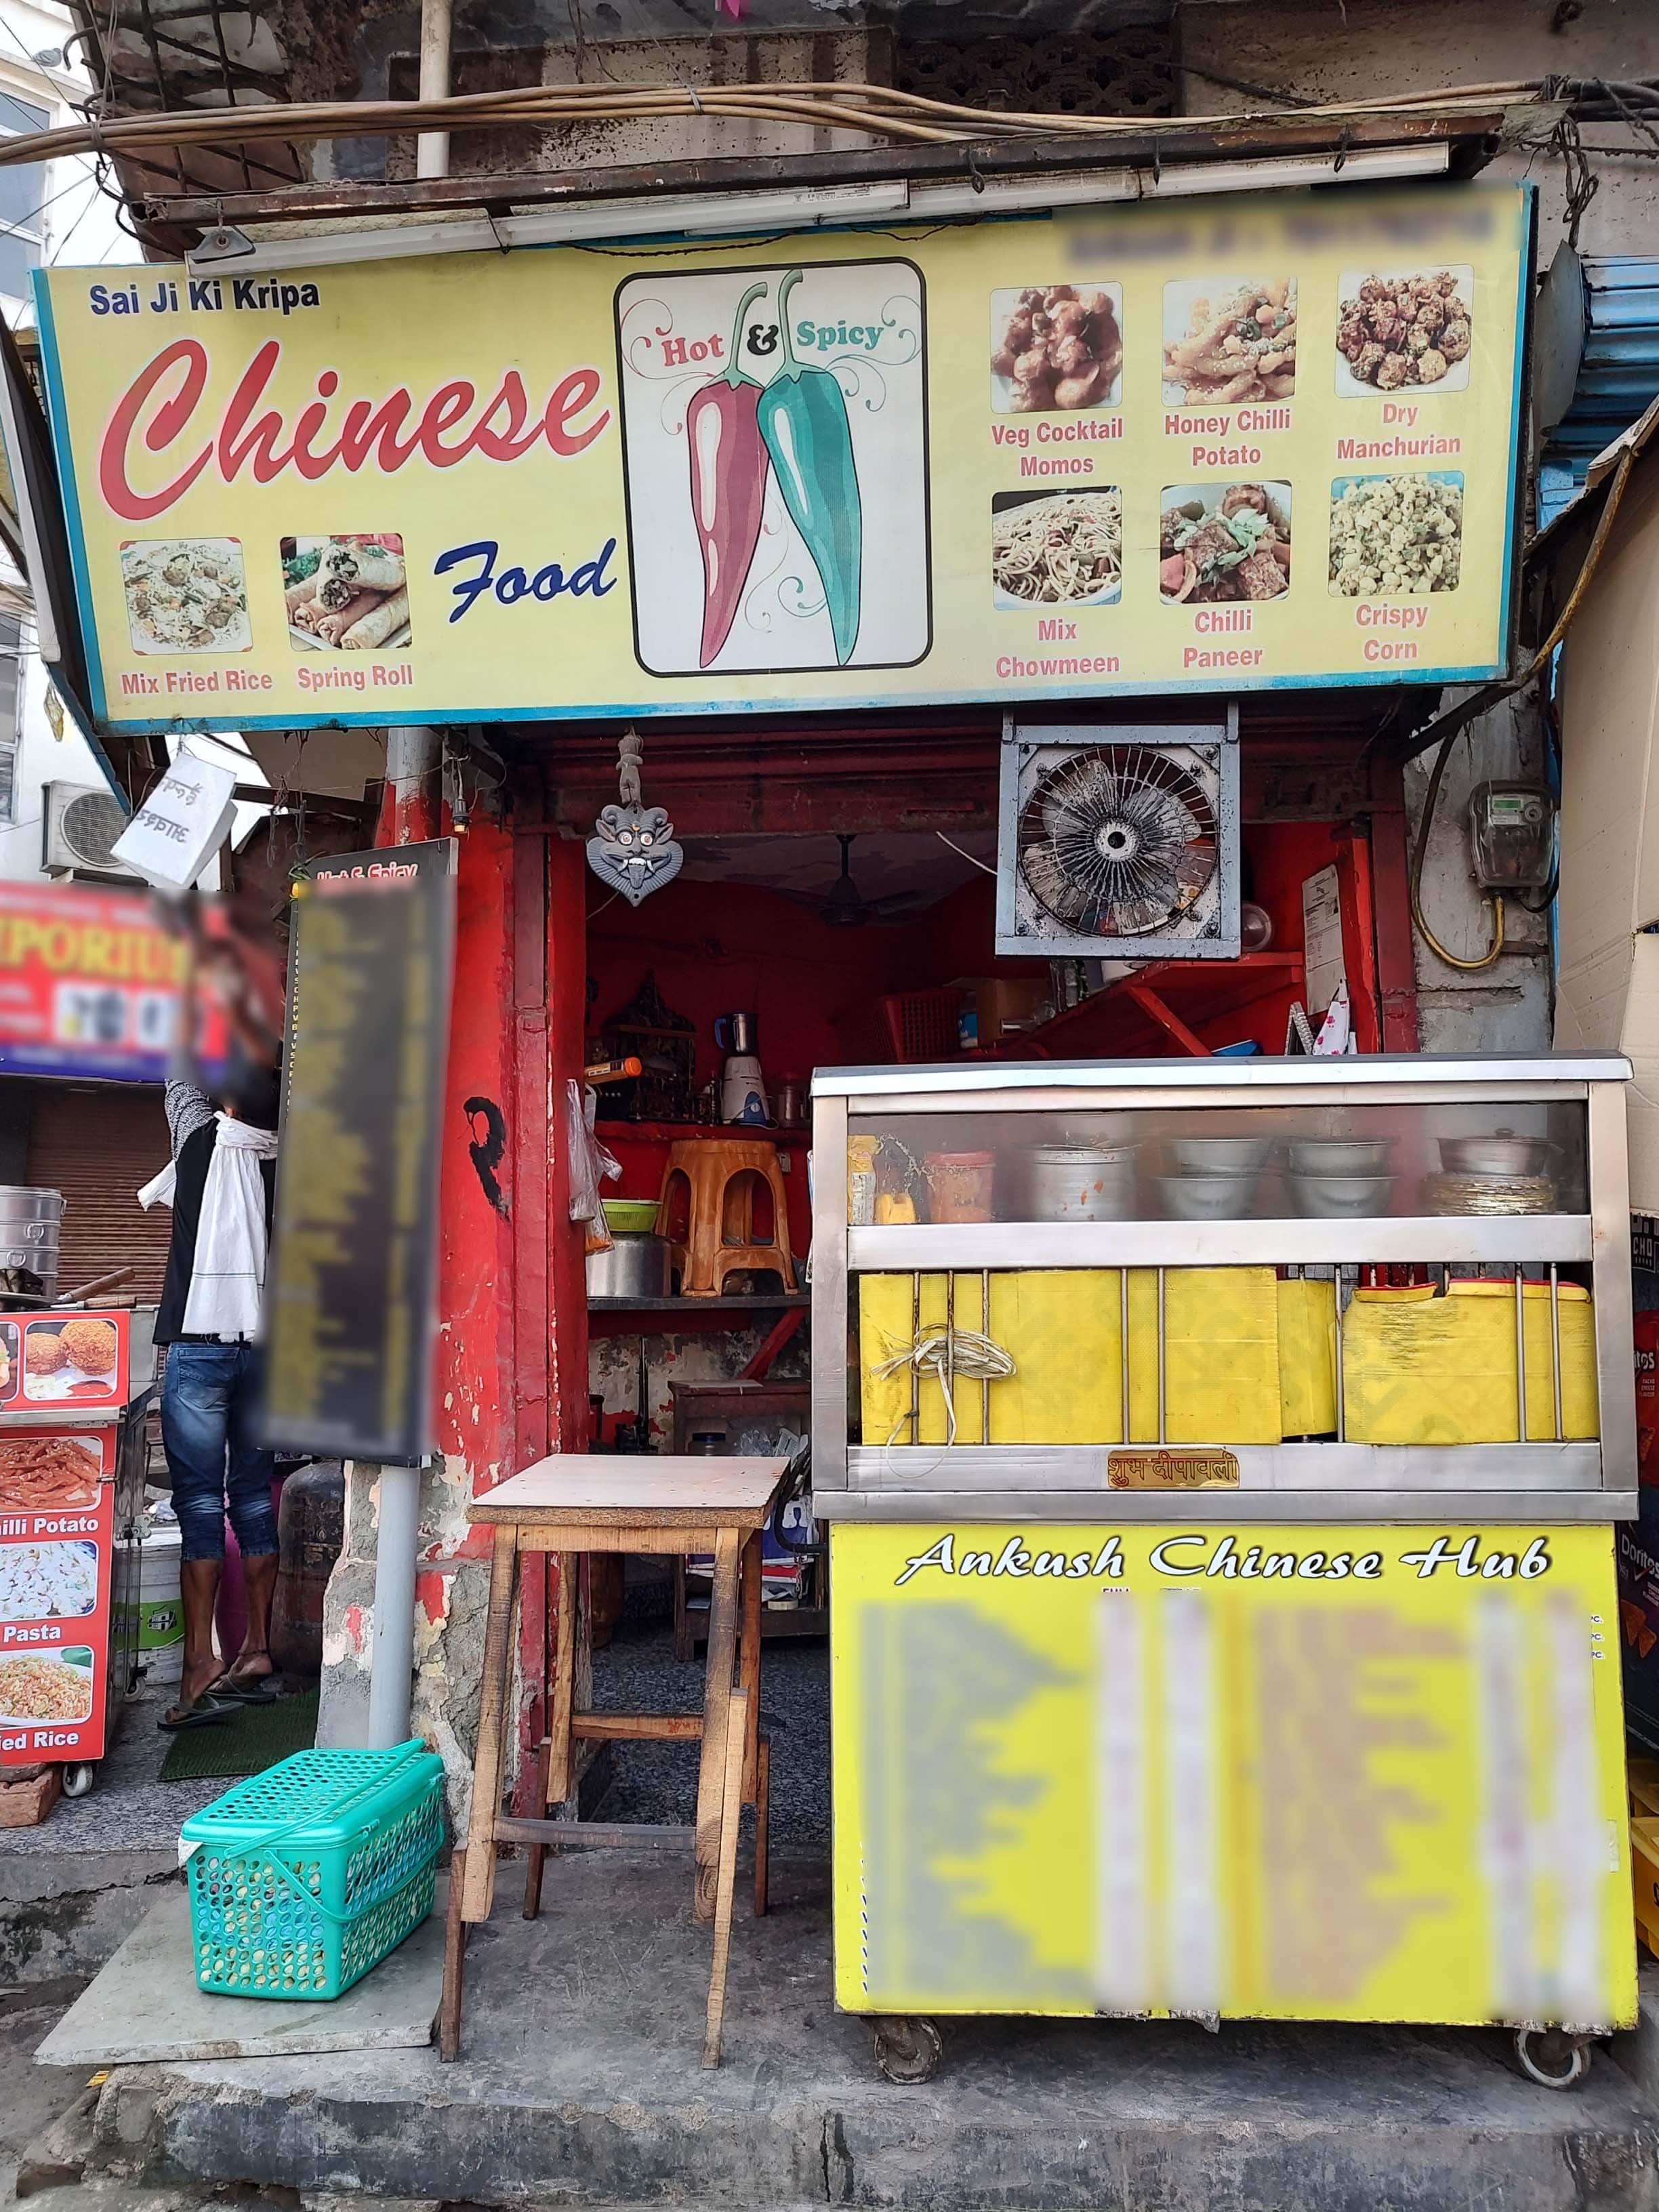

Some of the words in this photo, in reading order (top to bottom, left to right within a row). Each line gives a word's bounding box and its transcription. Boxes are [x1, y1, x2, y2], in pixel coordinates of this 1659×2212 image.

[89, 284, 138, 315] Sai
[151, 283, 179, 312] Ji
[189, 281, 223, 311] Ki
[234, 279, 321, 316] Kripa
[661, 334, 724, 367] Hot
[747, 324, 779, 356] &
[797, 320, 884, 352] Spicy
[1165, 413, 1230, 438] Honey
[1236, 409, 1291, 432] Chilli
[1383, 404, 1418, 426] Dry
[99, 338, 611, 522] Chinese
[991, 425, 1030, 448] Veg
[1036, 419, 1124, 442] Cocktail
[1193, 445, 1261, 467] Potato
[1337, 436, 1461, 460] Manchurian
[1021, 455, 1094, 476] Momos
[433, 539, 618, 625] Food
[1195, 611, 1252, 632] Chilli
[1355, 603, 1428, 628] Crispy
[1038, 620, 1078, 641] Mix
[1184, 646, 1263, 668] Paneer
[1364, 638, 1417, 661] Corn
[298, 666, 366, 693] Spring
[371, 664, 414, 687] Roll
[996, 655, 1120, 678] Chowmeen
[122, 673, 159, 695] Mix
[165, 670, 220, 693] Fried
[225, 670, 273, 691] Rice
[1108, 1457, 1145, 1486] शुभ
[1151, 1450, 1239, 1480] दीपावली
[0, 1518, 27, 1536] illi
[33, 1515, 99, 1534] Potato
[893, 1534, 1124, 1586] Ankush
[1148, 1537, 1382, 1579] Chinese
[1398, 1534, 1551, 1580] Hub
[1622, 1533, 1659, 1579] Doritos
[3, 1624, 62, 1643] Pasta
[33, 1730, 80, 1748] Rice
